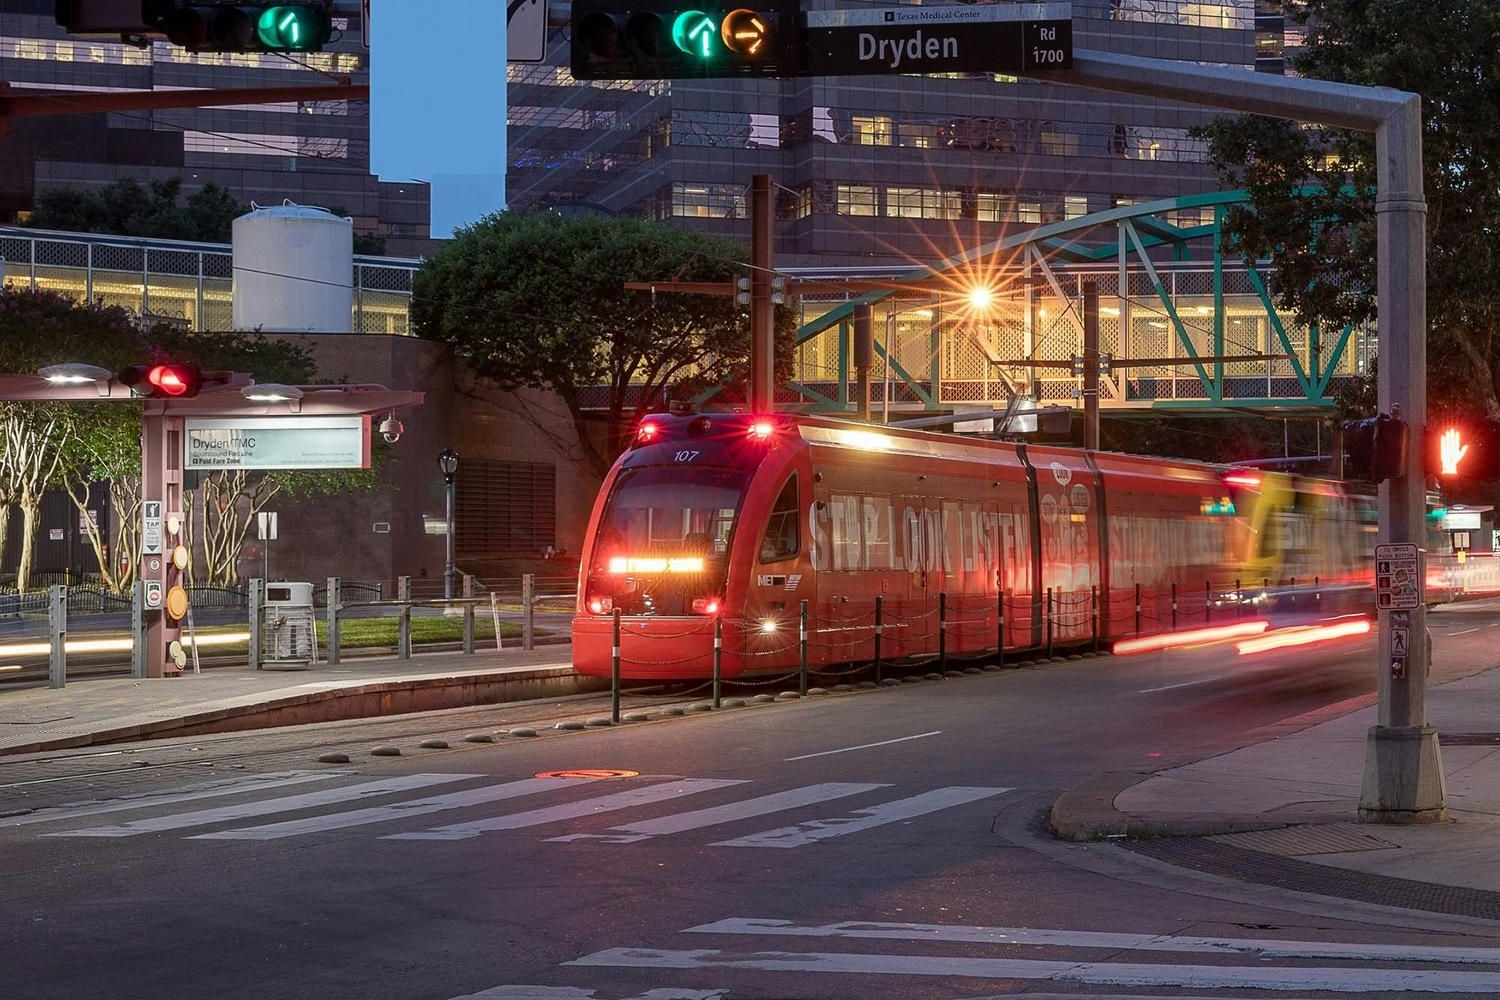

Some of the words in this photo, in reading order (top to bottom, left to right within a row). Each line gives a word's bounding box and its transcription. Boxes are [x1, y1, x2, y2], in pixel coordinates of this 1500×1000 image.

[897, 12, 919, 21] Texas
[920, 10, 952, 20] Medical
[953, 10, 981, 18] Center
[1040, 27, 1056, 40] Rd
[858, 30, 958, 68] Dryden
[1032, 49, 1064, 63] 1700
[674, 450, 700, 462] 107
